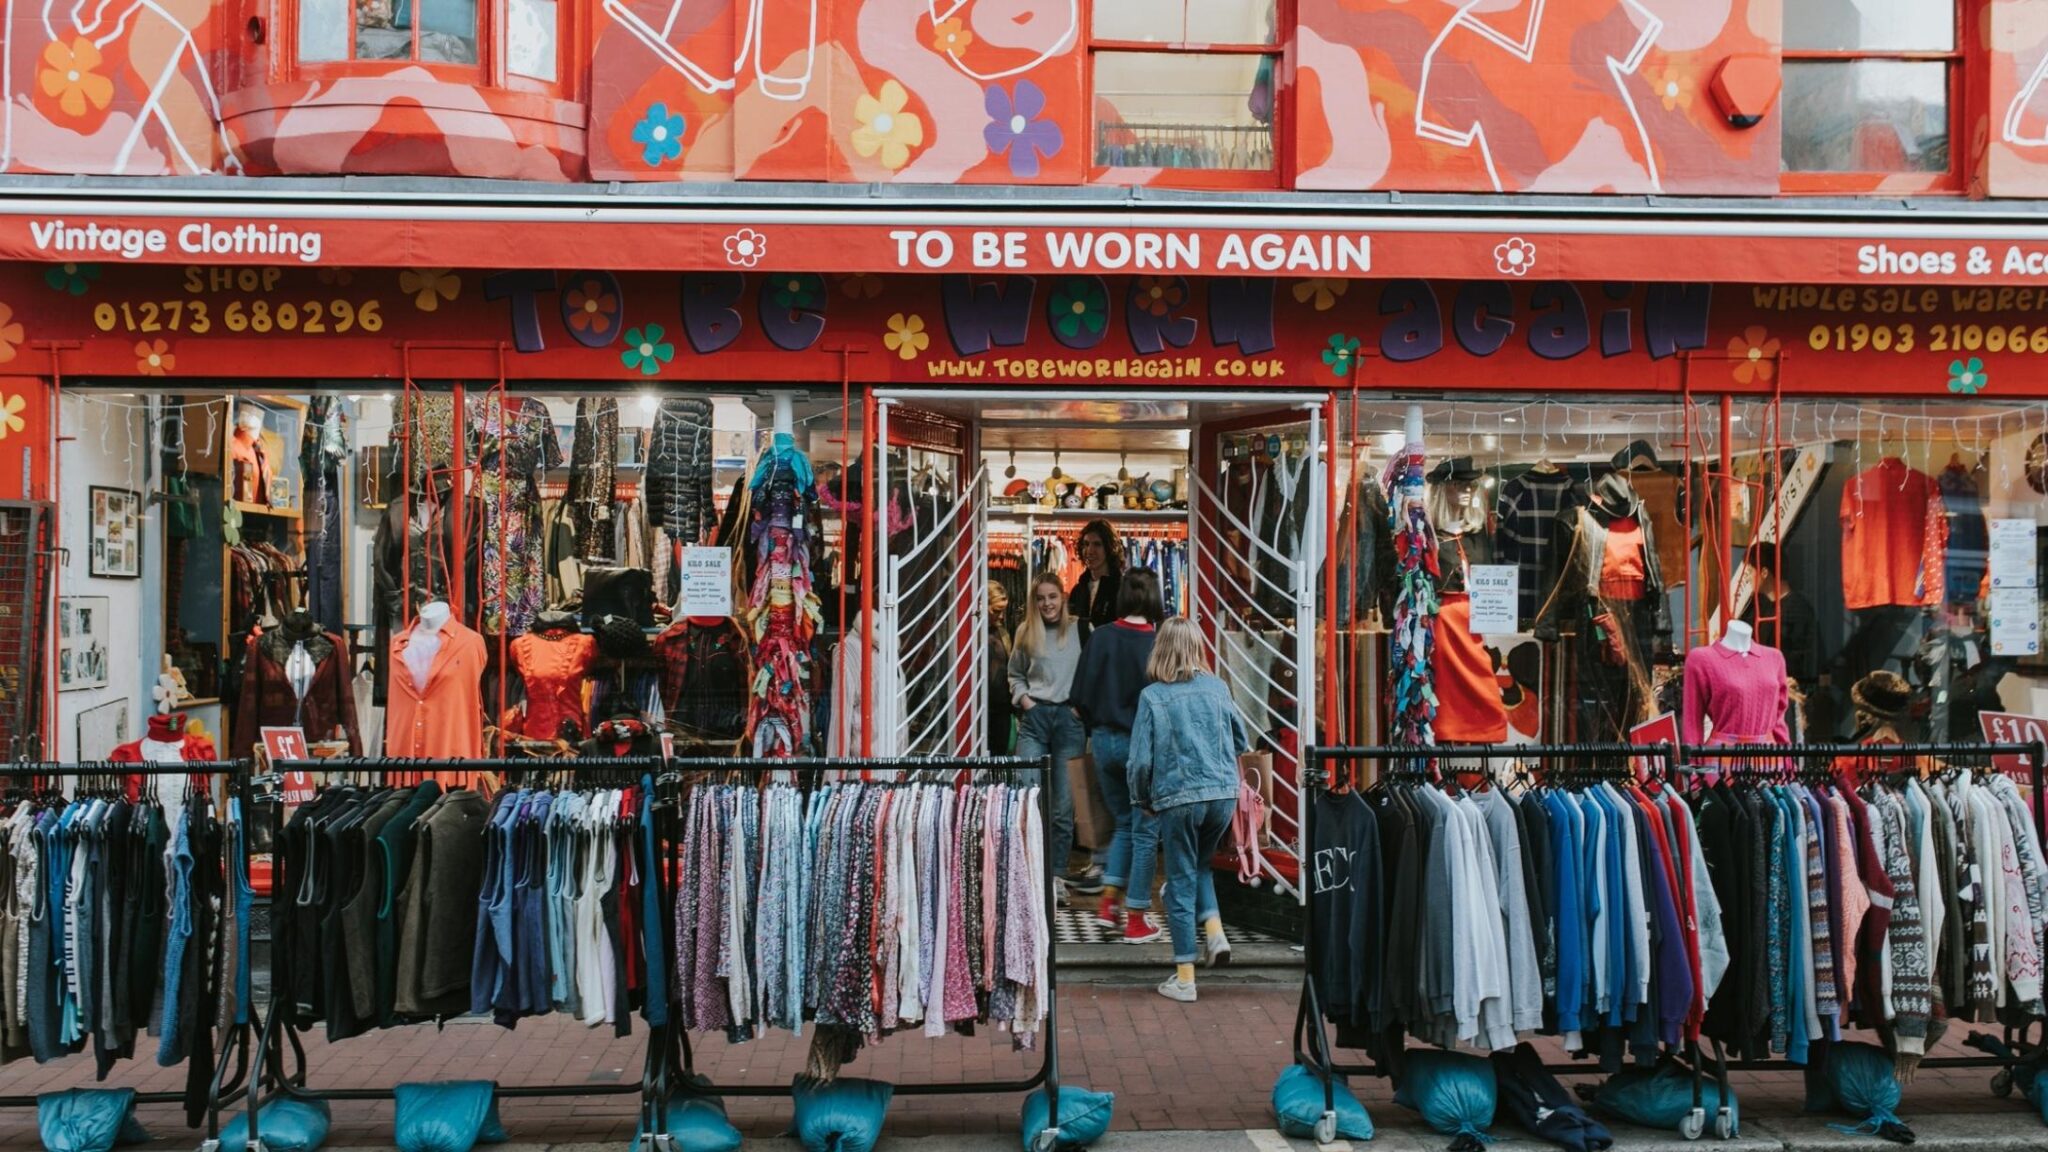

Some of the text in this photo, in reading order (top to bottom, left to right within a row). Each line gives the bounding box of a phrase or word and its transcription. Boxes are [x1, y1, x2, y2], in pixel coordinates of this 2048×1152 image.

[30, 221, 322, 263] Vintage Clothing
[889, 230, 1372, 272] TO BE WORN AGAIN
[1857, 244, 1957, 275] Shoes
[1965, 246, 1993, 276] &
[183, 266, 282, 293] SHOP
[94, 299, 383, 333] 01273 680296
[483, 269, 624, 353] TO
[1808, 324, 2048, 354] 01903 210066
